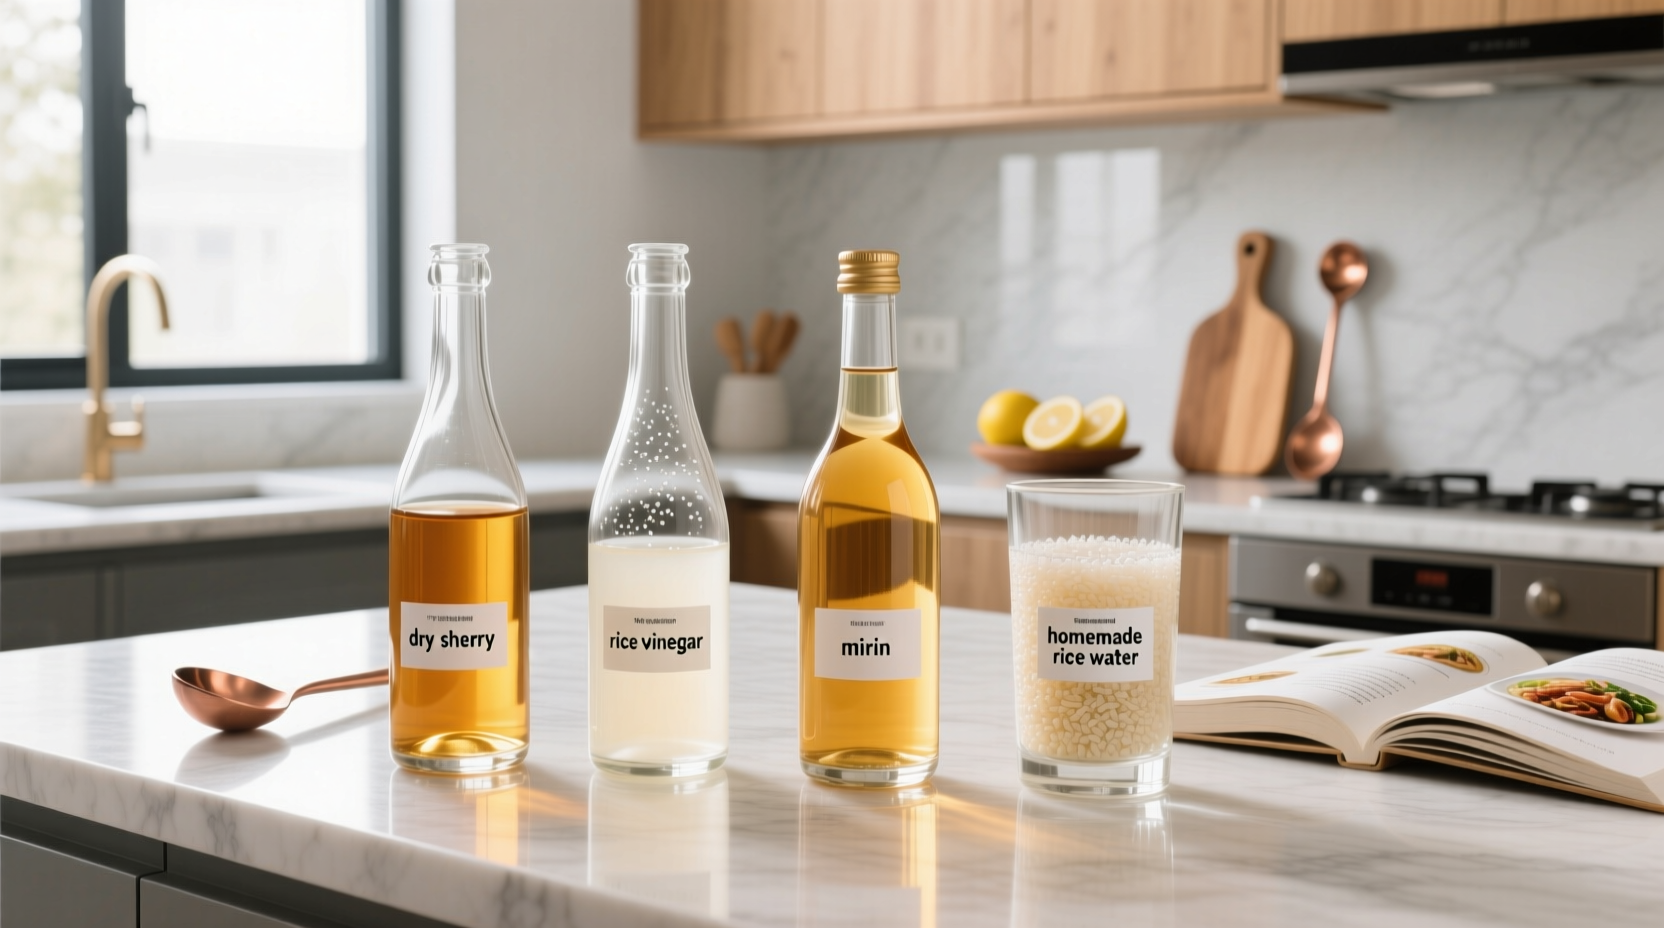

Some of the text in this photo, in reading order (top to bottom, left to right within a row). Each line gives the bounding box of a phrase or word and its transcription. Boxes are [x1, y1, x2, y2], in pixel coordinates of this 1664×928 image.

[408, 627, 495, 653] dry sherry
[609, 630, 704, 656] rice vinegar
[1047, 625, 1143, 646] homemade
[841, 637, 891, 657] mirin
[1053, 646, 1139, 666] rice water
